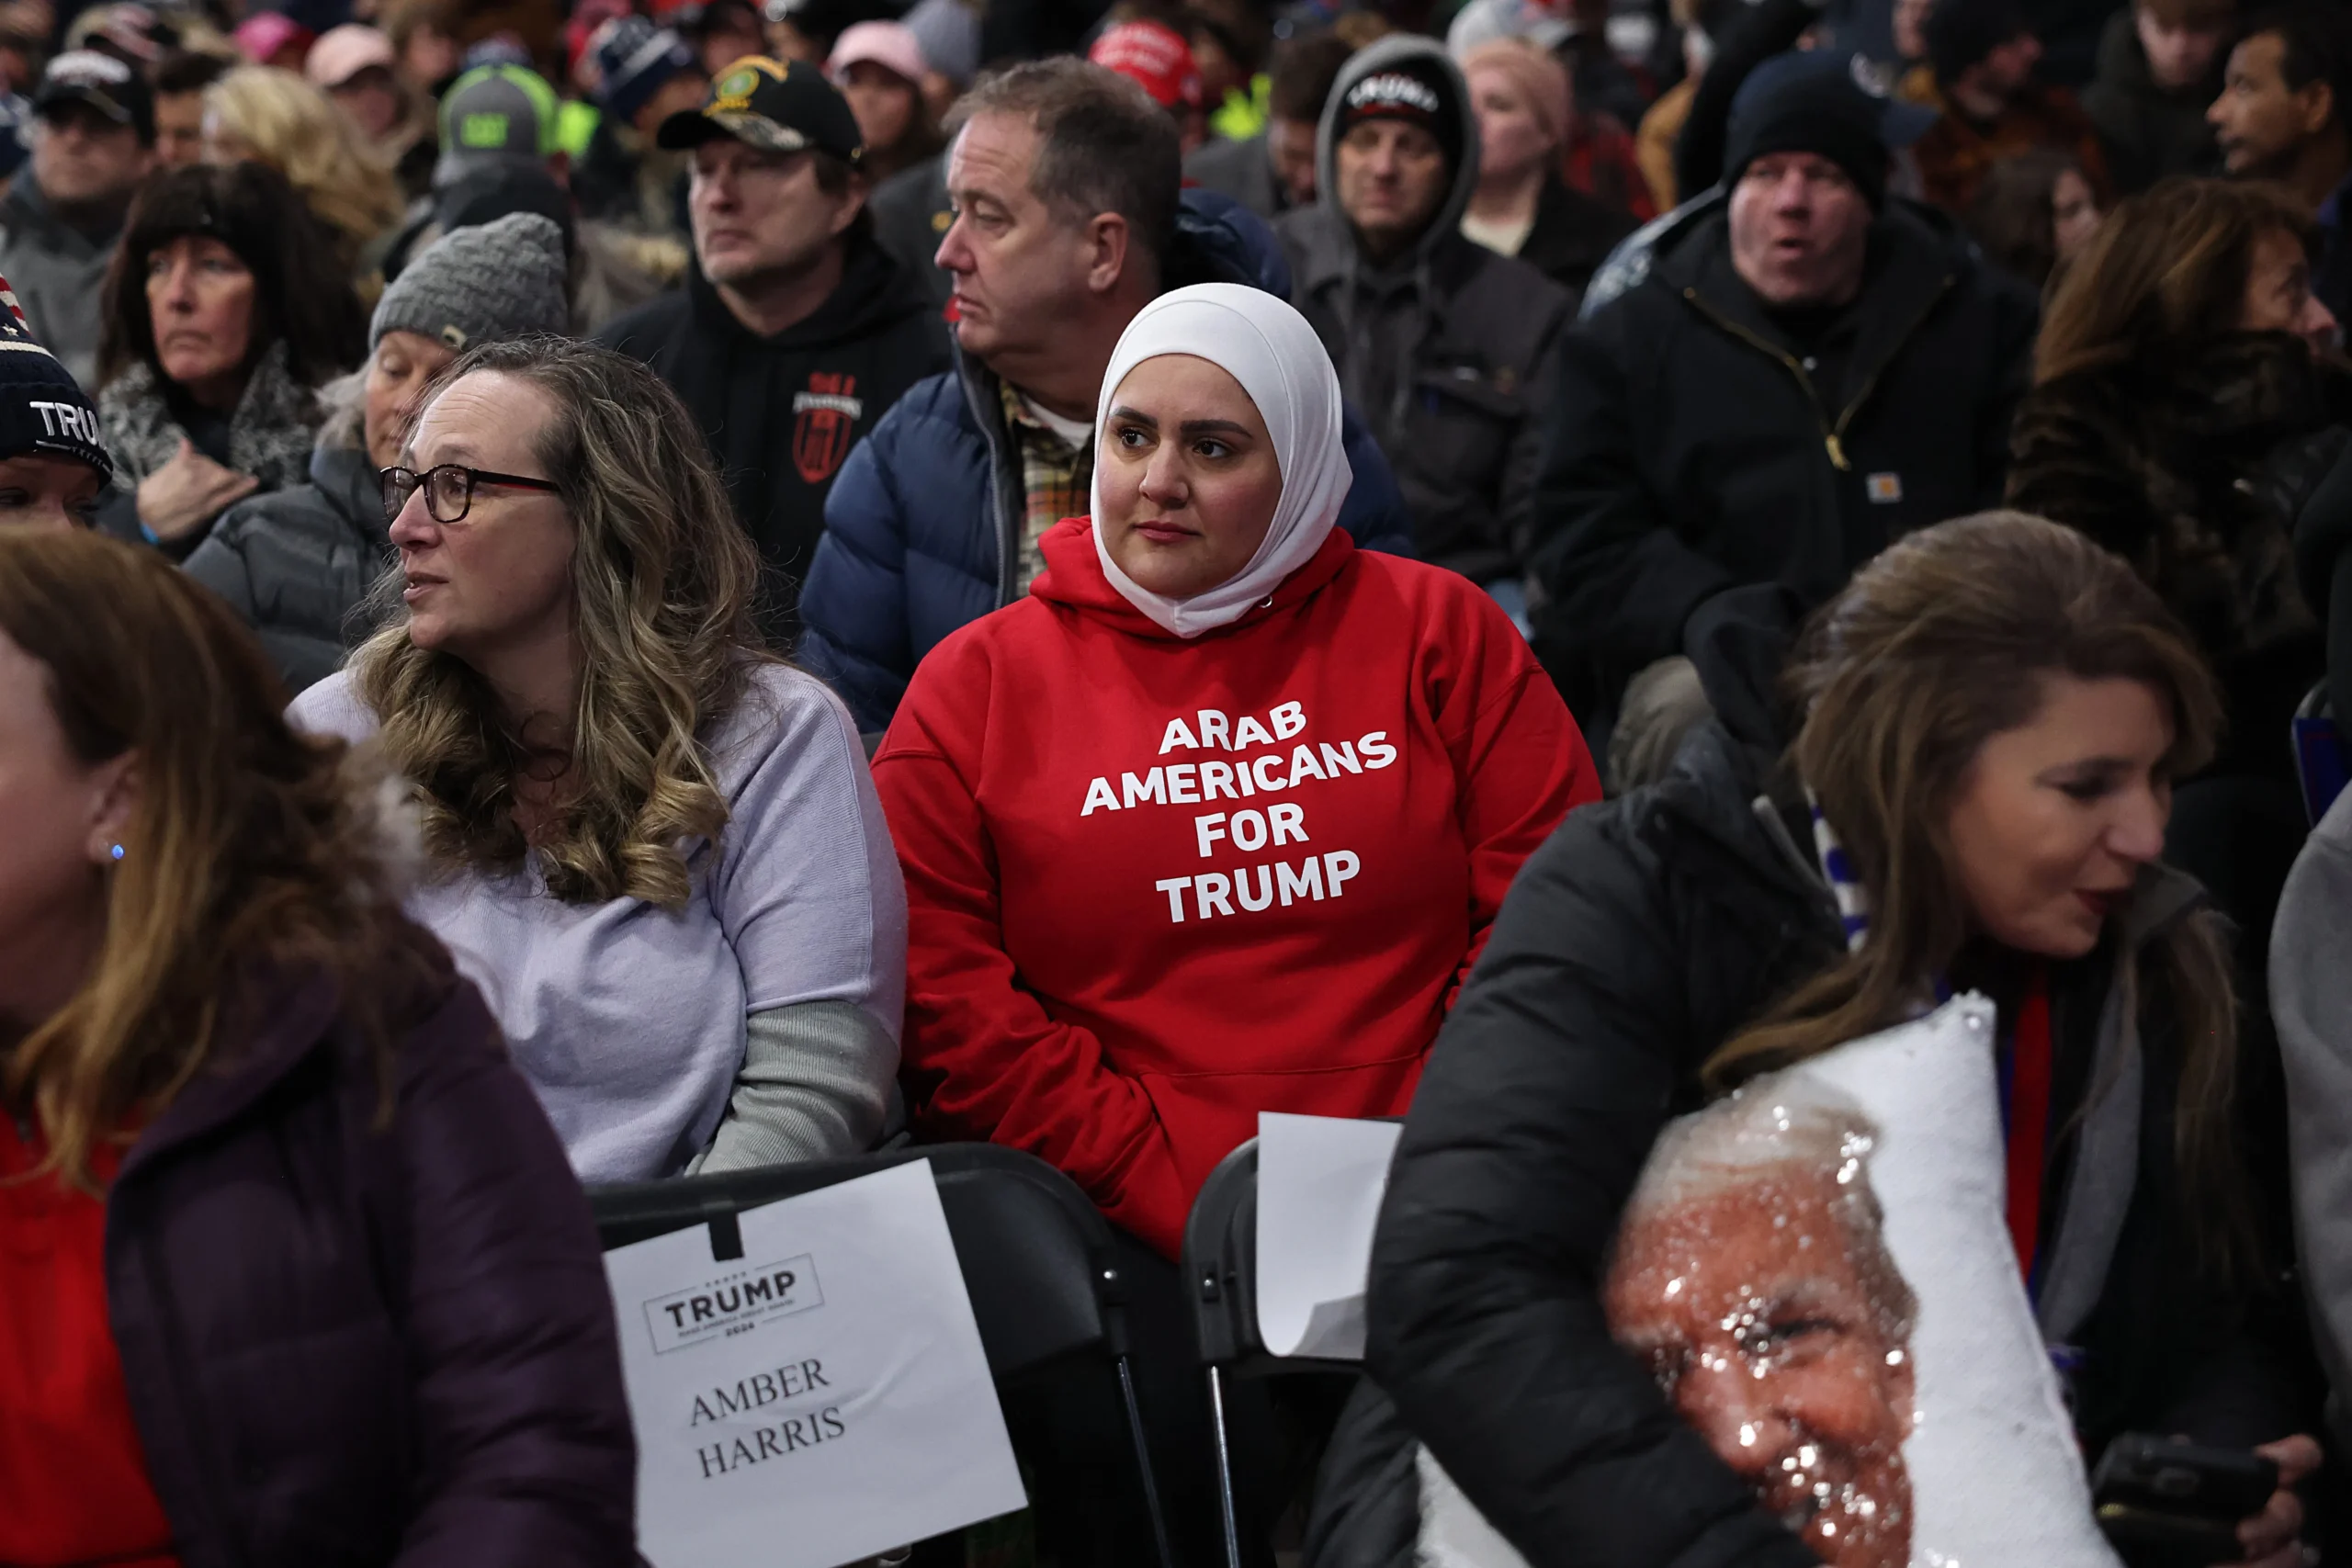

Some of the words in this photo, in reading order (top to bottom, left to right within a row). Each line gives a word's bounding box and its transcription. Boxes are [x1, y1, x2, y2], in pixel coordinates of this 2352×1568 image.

[29, 400, 107, 450] TRU
[1158, 700, 1306, 755] ARAB
[1080, 731, 1397, 817] AMERICANS
[1195, 803, 1309, 857] FOR
[1156, 850, 1361, 923] TRUMP
[664, 1270, 796, 1327] TRUMP
[726, 1321, 756, 1337] 2024
[691, 1358, 831, 1427] AMBER
[696, 1406, 845, 1479] HARRIS
